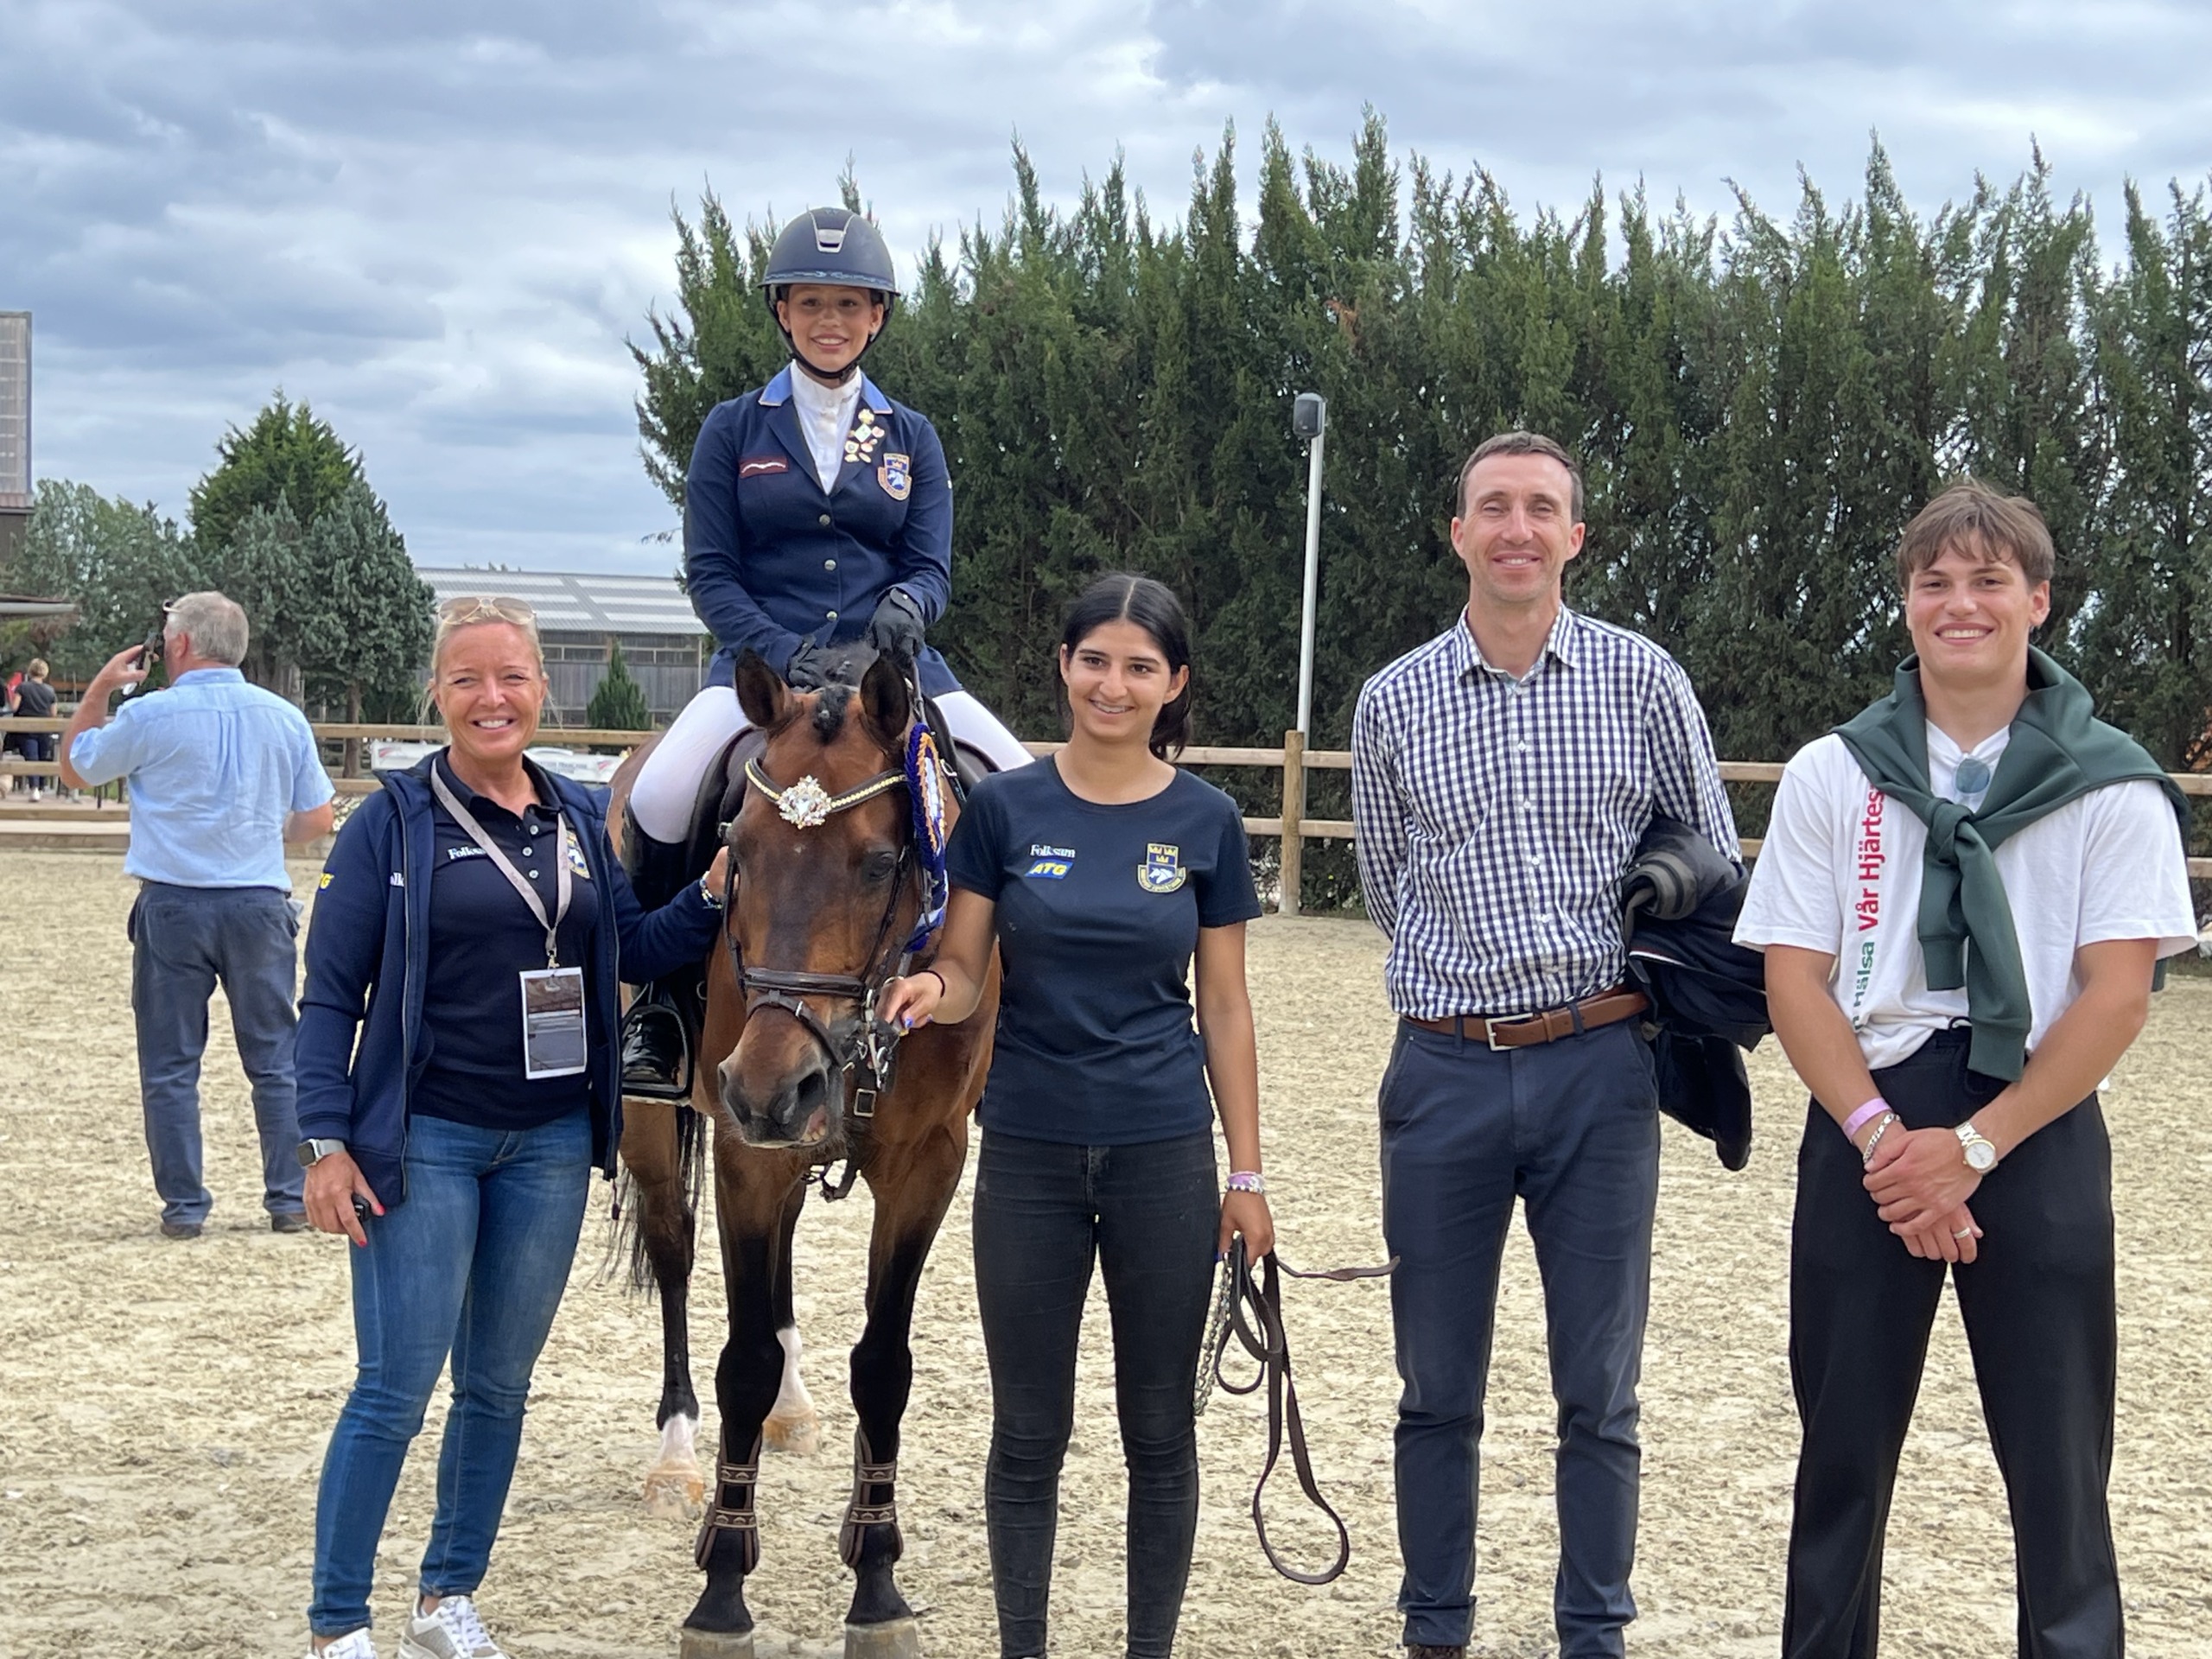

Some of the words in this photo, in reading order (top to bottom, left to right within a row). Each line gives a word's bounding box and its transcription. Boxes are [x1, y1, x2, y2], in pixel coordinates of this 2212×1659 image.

[1858, 784, 1885, 880] Hjärtes
[1030, 844, 1076, 858] Folksam
[1029, 862, 1067, 875] ATG
[1855, 887, 1879, 932] Vår
